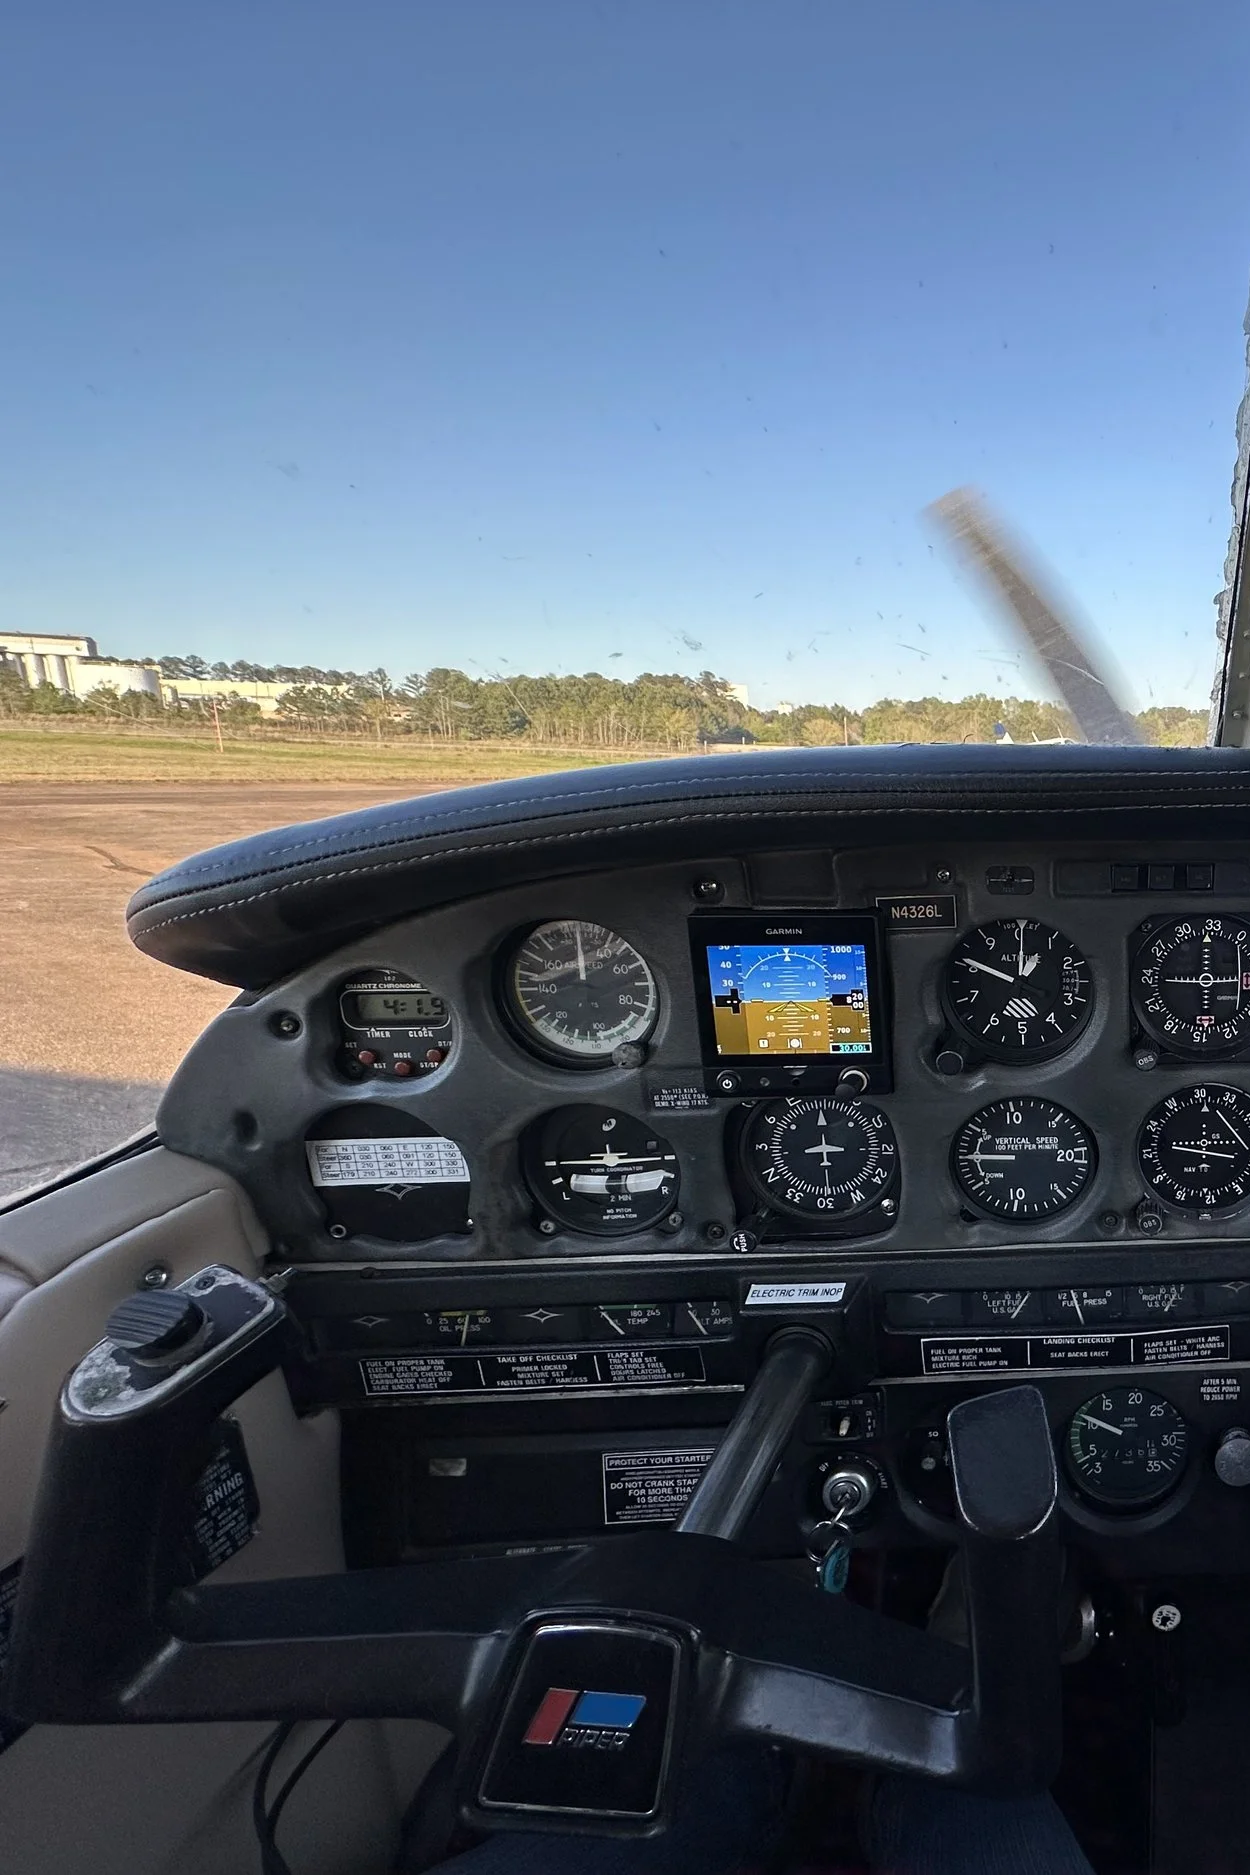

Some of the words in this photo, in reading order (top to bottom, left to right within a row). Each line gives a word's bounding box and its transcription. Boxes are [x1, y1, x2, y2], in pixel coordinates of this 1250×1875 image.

[892, 905, 942, 919] N4326L
[1175, 923, 1191, 937] 30
[1205, 919, 1221, 931] 33
[1237, 931, 1247, 940] 0
[986, 938, 995, 950] 9
[1049, 937, 1052, 950] 1
[1151, 939, 1166, 957] 27
[596, 949, 611, 958] 40
[544, 960, 562, 970] 160
[1063, 957, 1072, 969] 2
[613, 965, 628, 974] 60
[1141, 969, 1153, 984] 24
[539, 984, 556, 993] 140
[619, 995, 633, 1004] 80
[970, 990, 979, 1002] 7
[1064, 993, 1073, 1005] 3
[990, 1013, 999, 1025] 6
[1046, 1012, 1056, 1024] 4
[1018, 1022, 1027, 1034] 5
[1164, 1020, 1179, 1035] 18
[1223, 1026, 1239, 1039] 12
[408, 1030, 433, 1038] CLOCK
[1138, 1055, 1154, 1066] OBS
[1194, 1089, 1206, 1098] 30
[1223, 1091, 1236, 1104] 33
[765, 1115, 776, 1124] 6
[872, 1115, 883, 1128] S
[1006, 1112, 1022, 1124] 10
[756, 1142, 768, 1151] 3
[882, 1143, 894, 1154] 21
[1057, 1150, 1074, 1162] 20
[762, 1167, 780, 1183] N
[870, 1167, 888, 1185] 24
[562, 1192, 570, 1200] L
[661, 1186, 668, 1195] R
[785, 1188, 804, 1203] 33
[851, 1189, 866, 1204] W
[1010, 1188, 1025, 1200] 10
[817, 1198, 835, 1208] 30
[738, 1234, 748, 1252] PUSH
[751, 1289, 795, 1298] ELECTRIC
[798, 1288, 819, 1297] TRIM
[821, 1288, 843, 1296] INOP
[536, 1354, 578, 1362] CHECKLIST
[1128, 1393, 1143, 1404] 20
[1102, 1399, 1112, 1411] 15
[1150, 1405, 1164, 1416] 25
[1161, 1434, 1176, 1446] 30
[609, 1458, 647, 1466] PROTECT
[1146, 1461, 1161, 1472] 35
[645, 1480, 674, 1488] CRANK
[648, 1495, 688, 1503] SECONDS
